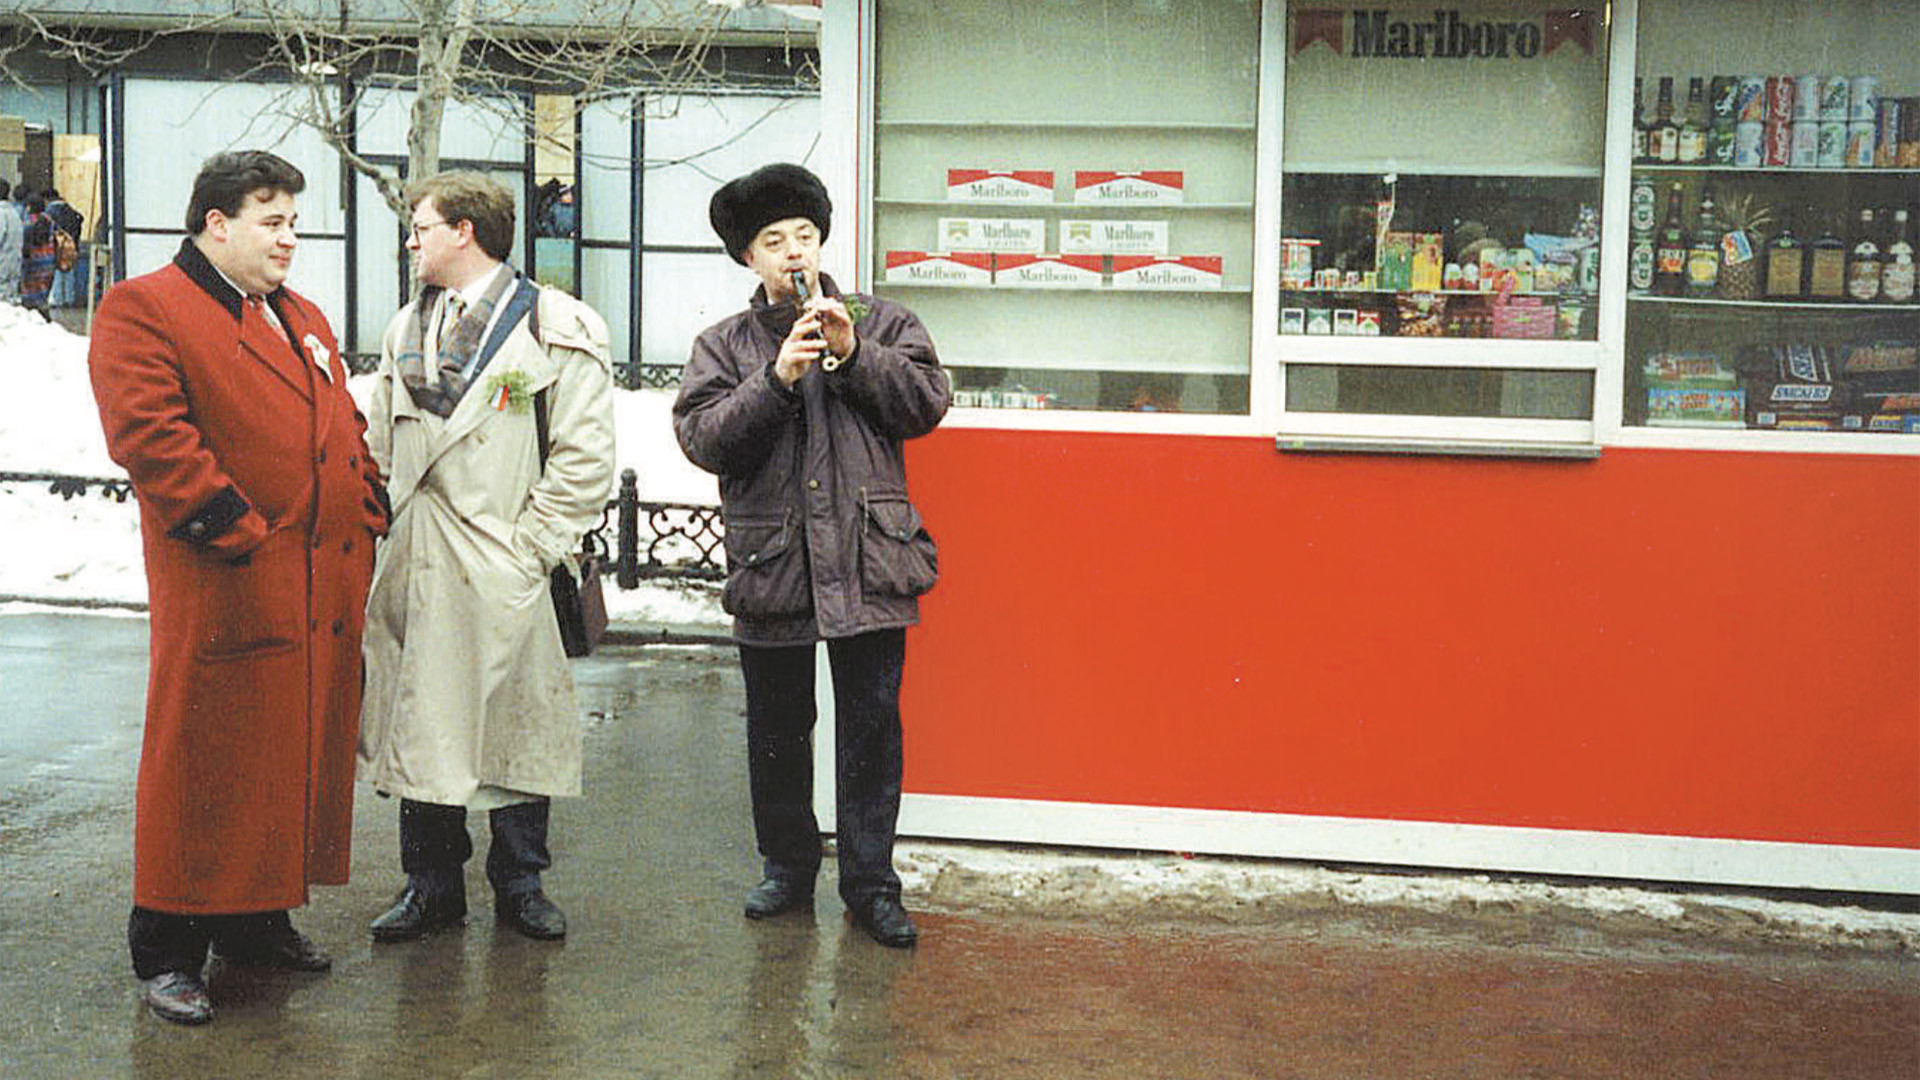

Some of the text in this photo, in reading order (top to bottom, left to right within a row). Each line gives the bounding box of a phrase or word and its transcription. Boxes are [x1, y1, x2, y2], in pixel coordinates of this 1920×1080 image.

[1351, 9, 1541, 59] Marlboro
[971, 183, 1030, 199] Marlboro
[1099, 185, 1158, 199] Marlboro
[909, 266, 967, 281] Marlboro
[1019, 268, 1078, 283] Marlboro
[1137, 270, 1197, 285] Marlboro
